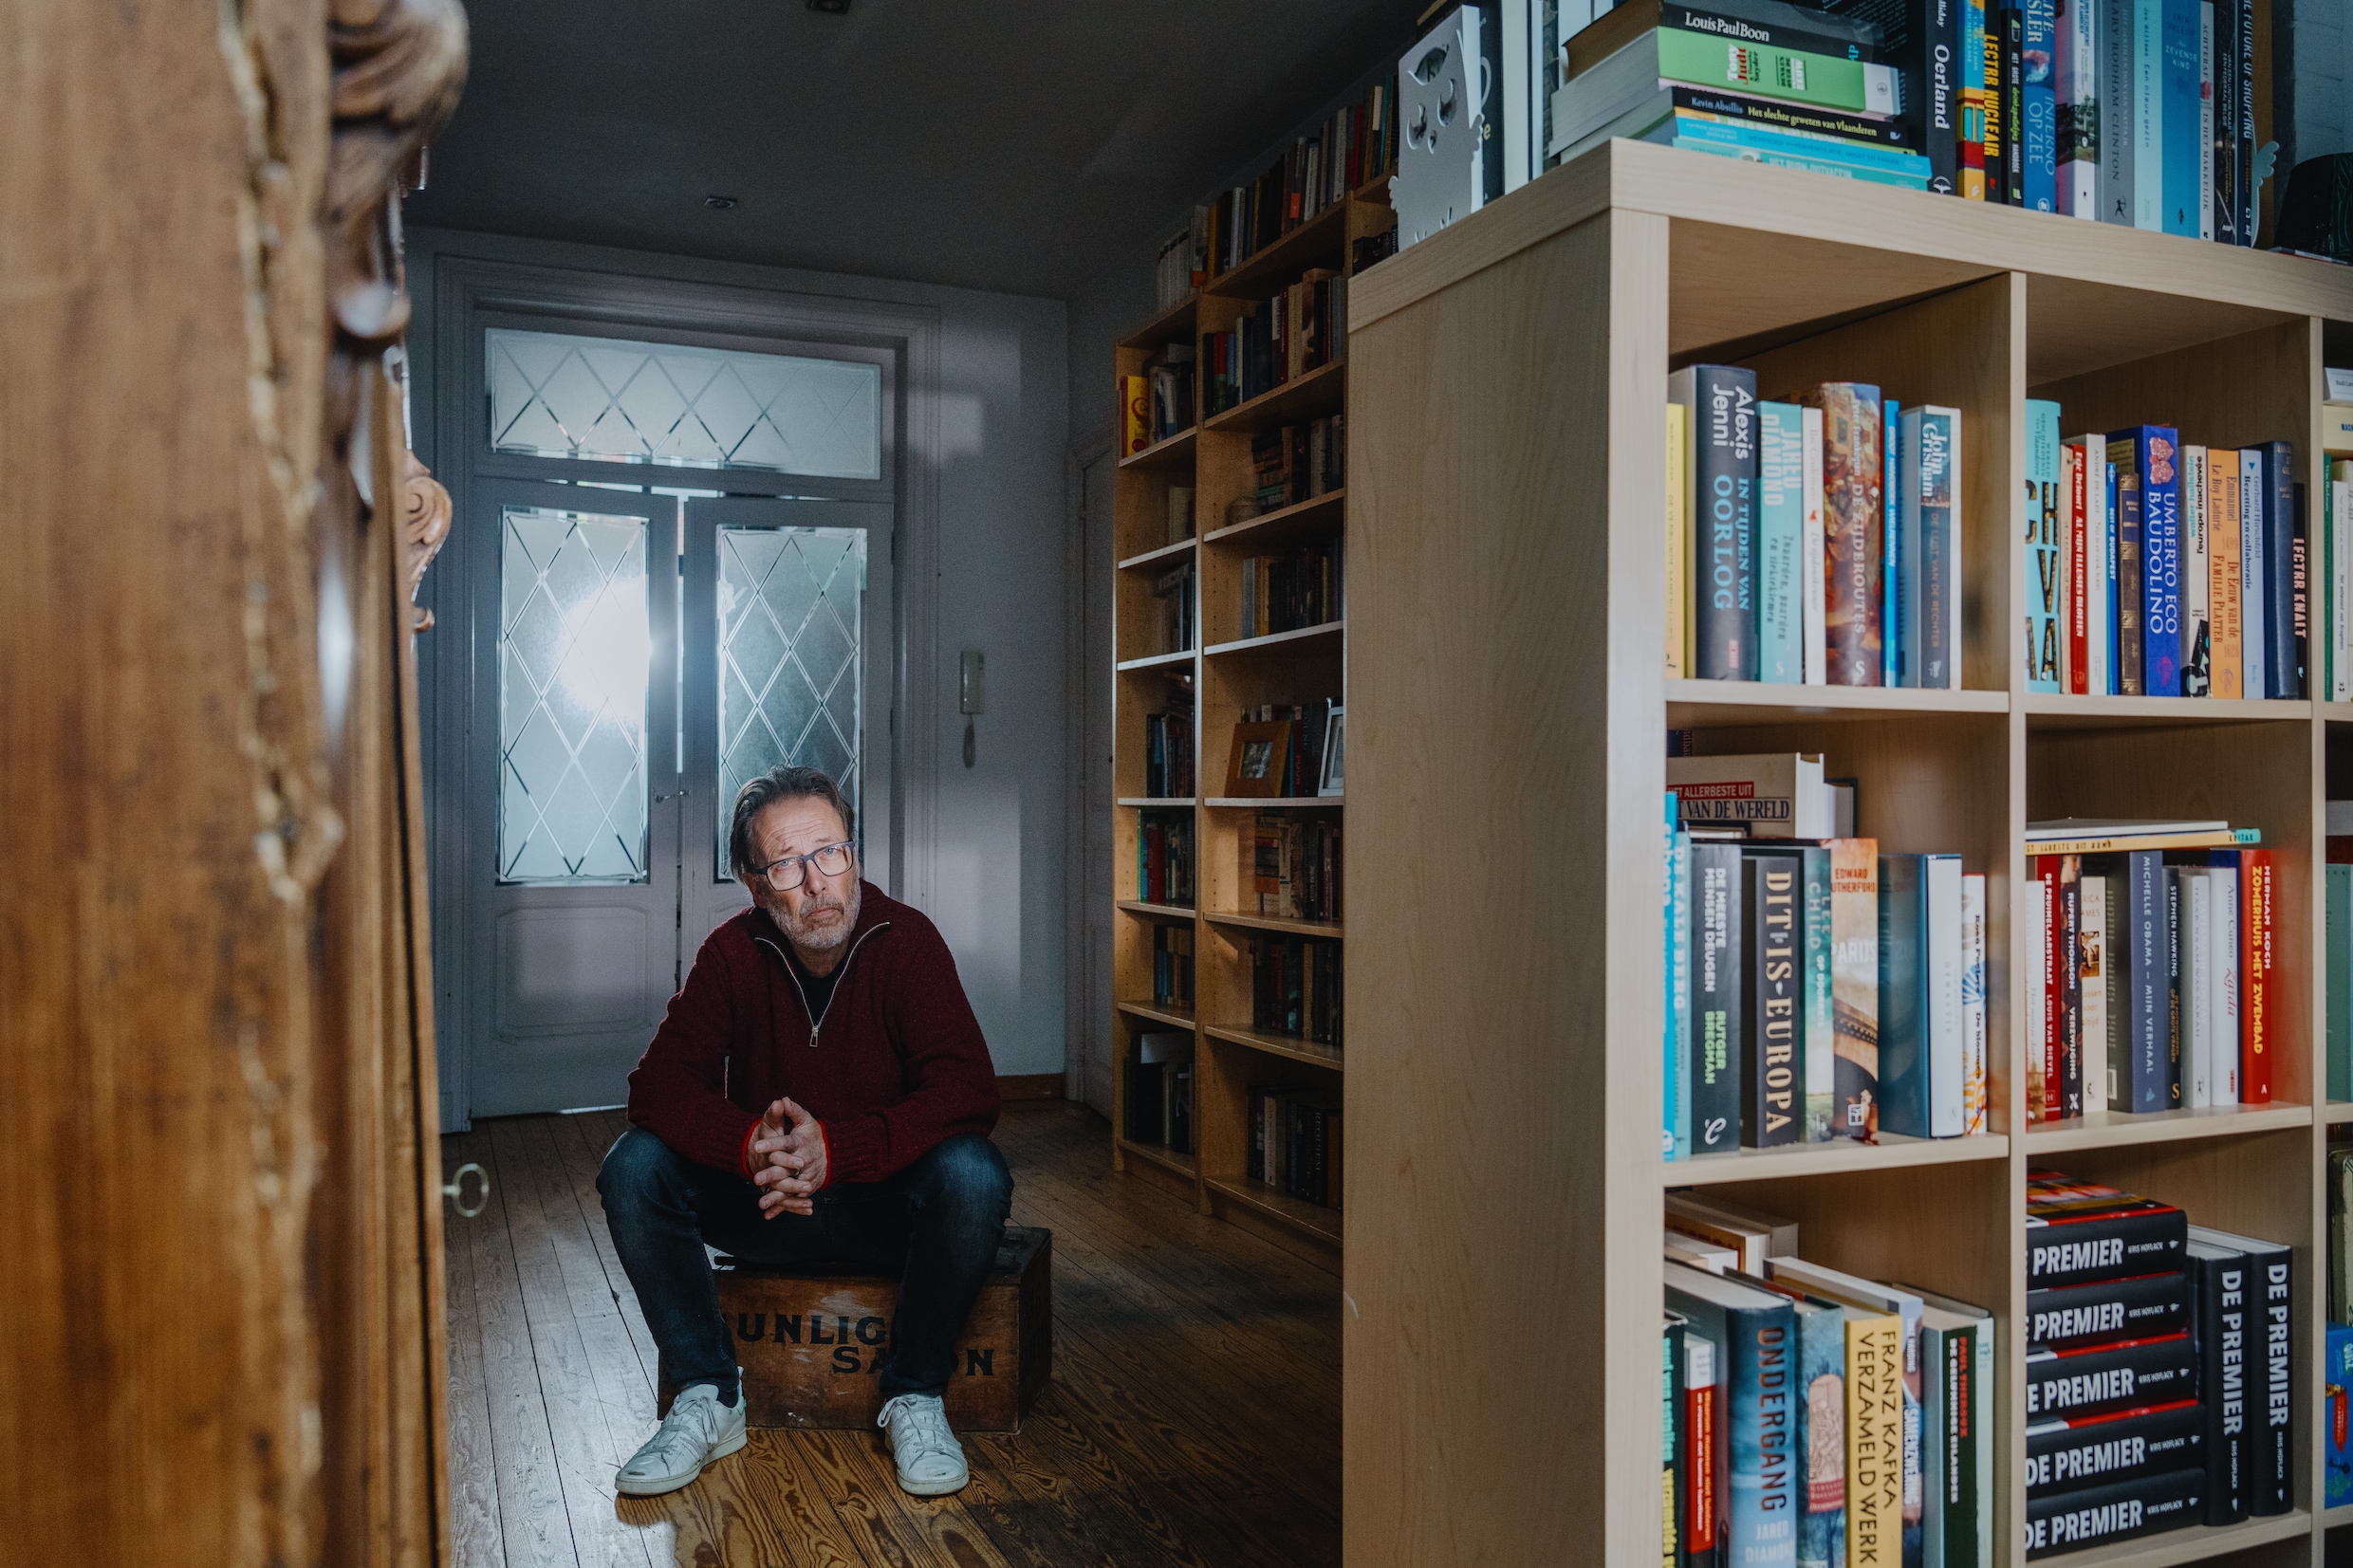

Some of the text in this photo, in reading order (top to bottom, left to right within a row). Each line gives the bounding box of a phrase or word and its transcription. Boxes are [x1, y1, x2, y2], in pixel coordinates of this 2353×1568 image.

[1727, 43, 1740, 82] Tony
[1737, 47, 1750, 85] Judt
[2111, 43, 2120, 106] RODHAM
[2165, 45, 2198, 63] ZEVENDE
[2172, 59, 2191, 71] KIND
[2243, 13, 2253, 139] FUTURE SHOPPING
[1691, 96, 1714, 110] Kevin
[1714, 99, 1744, 115] Absillis
[1748, 105, 1763, 118] Het
[1764, 107, 1789, 122] slechte
[1790, 112, 1821, 130] geweten
[1822, 118, 1836, 130] van
[1835, 118, 1878, 138] Vlaanderen
[1934, 44, 1951, 130] Oerland
[1984, 34, 2000, 158] LECTRR NUCLEAIR
[2029, 101, 2044, 164] OP ZEE
[2045, 96, 2055, 176] INFERNO
[1713, 383, 1735, 447] Jenni
[1735, 386, 1754, 460] Alexis
[1760, 413, 1784, 507] DIAMOND
[1780, 427, 1802, 489] JARED
[1921, 422, 1938, 497] Grisham
[1933, 434, 1948, 475] John
[1850, 484, 1865, 507] DE
[2211, 464, 2222, 532] Le Roy Ladurie
[2226, 475, 2237, 522] Emmanuel
[2252, 475, 2261, 559] Gerhard Hirschfeld
[1713, 473, 1734, 611] OORLOG
[1737, 477, 1750, 611] IN TIJDEN VAN
[1887, 507, 1896, 567] WIELRENNEN
[2148, 491, 2164, 636] BAUDOLINO
[2164, 492, 2177, 635] UMBERTO ECO
[2243, 475, 2251, 590] Bezetting collaboratie
[1851, 512, 1866, 634] ZIJDEROUTES
[2212, 554, 2225, 644] FAMILIE PLATTER
[2227, 561, 2239, 628] De Eeuw van
[2293, 537, 2307, 638] LECTRR KNALT
[1930, 600, 1939, 648] RECHTER
[1684, 784, 1753, 799] ALLERBESTE UIT
[1687, 800, 1791, 821] VAN DE WERELD
[1673, 844, 1686, 875] DE
[1835, 867, 1869, 880] EDWARD
[2046, 873, 2053, 885] DE
[1673, 880, 1686, 947] KALE
[1704, 868, 1715, 992] MENSEN DEUGEN
[1715, 868, 1727, 948] DE MEESTE
[1765, 871, 1793, 930] DIT
[1807, 882, 1823, 950] CHILD
[1821, 895, 1831, 935] LEE
[1765, 947, 1793, 983] IS
[2045, 887, 2053, 986] PRUIMELAARSTRAAT
[2142, 856, 2154, 1075] MICHELLE OBAMA MIJN VERHAAL
[2170, 928, 2178, 978] HAWKING
[2251, 865, 2264, 1055] ZOMERHUIS MET ZWEMBAD
[1674, 948, 1686, 1009] BERG
[1704, 1010, 1715, 1085] BREGMAN
[1715, 1010, 1727, 1070] RUTGER
[1765, 997, 1793, 1134] EUROPA
[2068, 1005, 2077, 1080] VERZWIJGING
[2032, 1237, 2124, 1277] PREMIER
[2222, 1270, 2242, 1308] DE
[2268, 1264, 2288, 1301] DE
[2033, 1301, 2125, 1342] PREMIER
[831, 1345, 996, 1377] SAN
[1906, 1338, 1917, 1374] HARDING
[1958, 1336, 1969, 1438] PAUL THEROUX
[2222, 1312, 2243, 1437] PREMIER
[2269, 1304, 2289, 1428] PREMIER
[1757, 1325, 1787, 1513] ONDERGANG
[1881, 1330, 1899, 1510] FRANZ KAFKA
[1950, 1337, 1959, 1504] DE GELUKKIGE EILANDEN
[2043, 1367, 2135, 1411] PREMIER
[1857, 1331, 1879, 1565] VERZAMELD WERK
[1903, 1407, 1919, 1505] SAMENZWERING
[2025, 1454, 2050, 1488] DE
[2054, 1436, 2146, 1482] PREMIER
[1746, 1539, 1796, 1564] DIAMOND
[1756, 1519, 1789, 1540] JARED
[2050, 1499, 2143, 1546] PREMIER
